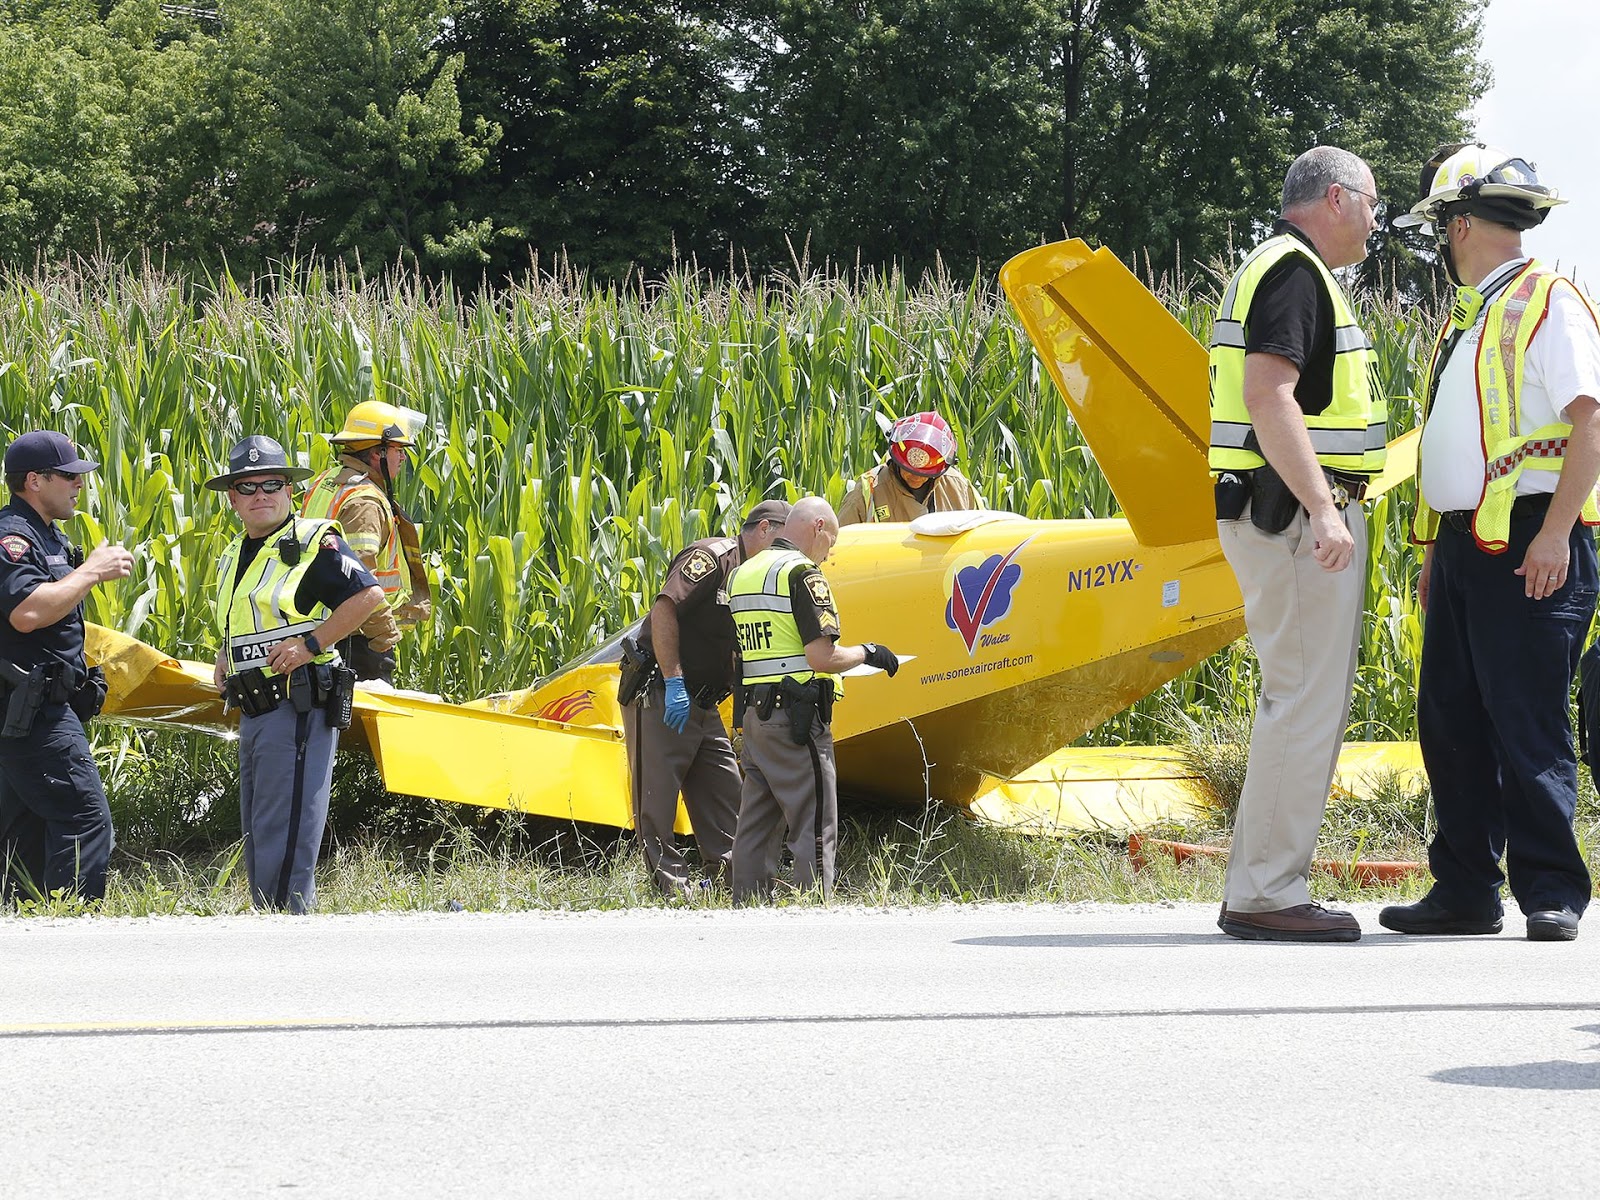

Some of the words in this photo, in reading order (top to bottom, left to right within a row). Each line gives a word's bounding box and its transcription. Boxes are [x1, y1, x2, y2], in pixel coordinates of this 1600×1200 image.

[1486, 347, 1500, 425] FIRE
[1068, 559, 1134, 592] N12YX
[242, 640, 283, 660] PAT
[738, 621, 772, 651] ERIFF
[980, 633, 1011, 648] Waiex
[920, 654, 1033, 685] www.sonexaircraft.com
